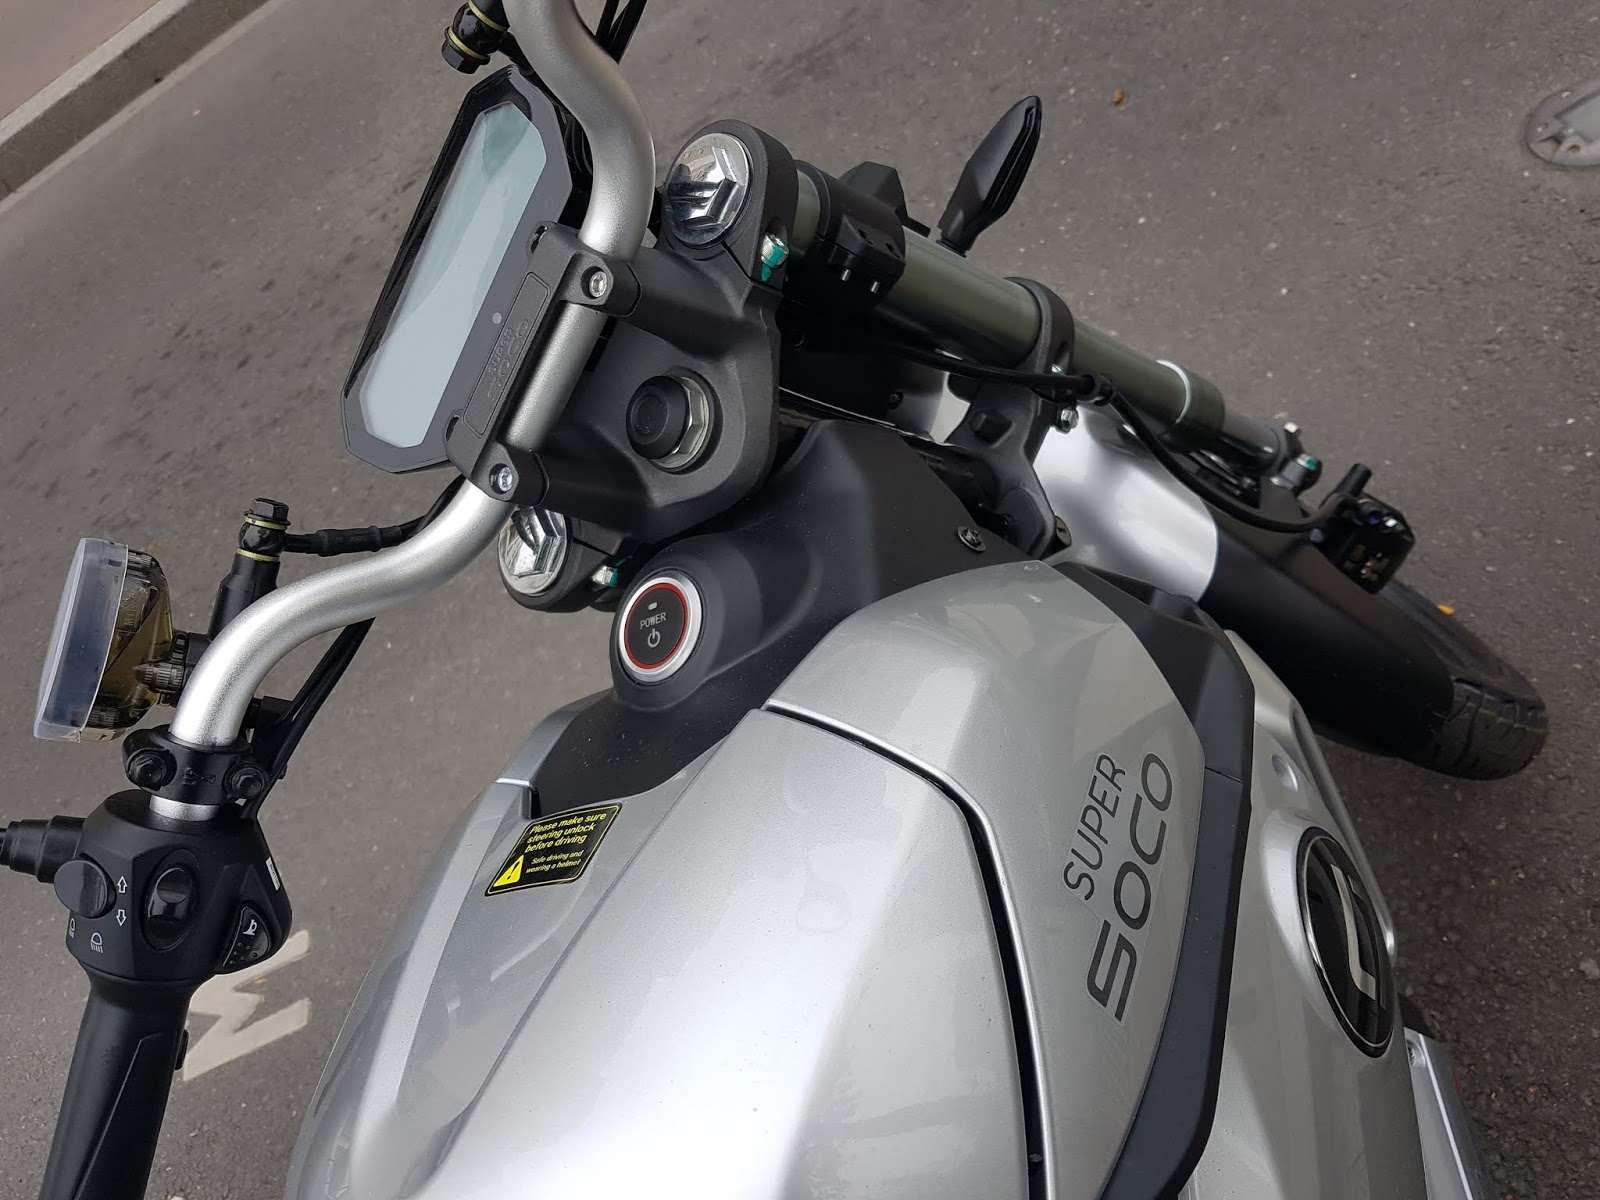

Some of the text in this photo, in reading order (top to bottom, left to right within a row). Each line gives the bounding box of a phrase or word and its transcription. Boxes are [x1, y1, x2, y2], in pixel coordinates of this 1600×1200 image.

[640, 612, 667, 630] POWER
[527, 822, 597, 844] steering unlock
[530, 813, 607, 834] Please make sure
[1063, 753, 1126, 901] SUPER
[524, 834, 588, 853] before driving
[525, 864, 551, 874] wearing
[556, 859, 581, 869] helmet
[531, 849, 584, 864] Safe driving and
[1086, 752, 1173, 1021] SOCO
